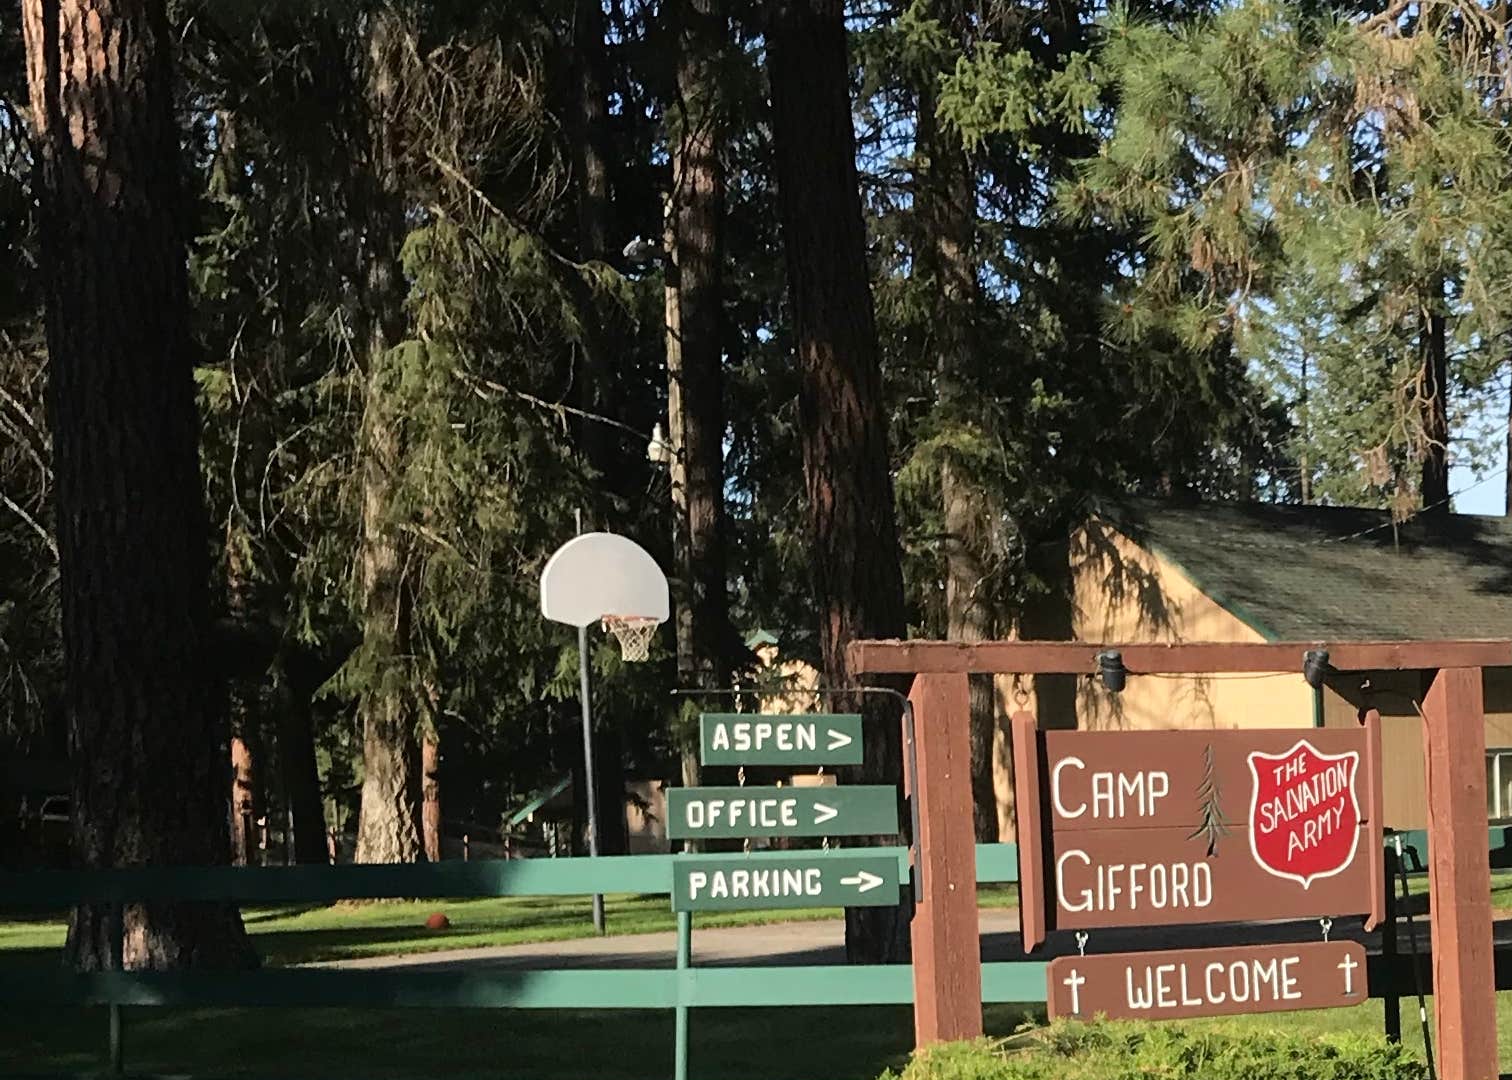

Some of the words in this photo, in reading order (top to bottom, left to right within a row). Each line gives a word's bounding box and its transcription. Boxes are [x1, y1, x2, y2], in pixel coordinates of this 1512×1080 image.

[712, 723, 816, 751] ASPEN
[1053, 757, 1169, 819] CAMP
[1273, 751, 1307, 786] THE
[687, 799, 798, 828] OFFICE
[1259, 760, 1349, 834] SALVATION
[1287, 797, 1345, 862] ARMY
[688, 868, 822, 900] PARKING
[1056, 849, 1213, 912] GIFFORD
[1126, 956, 1302, 1009] WELCOME
